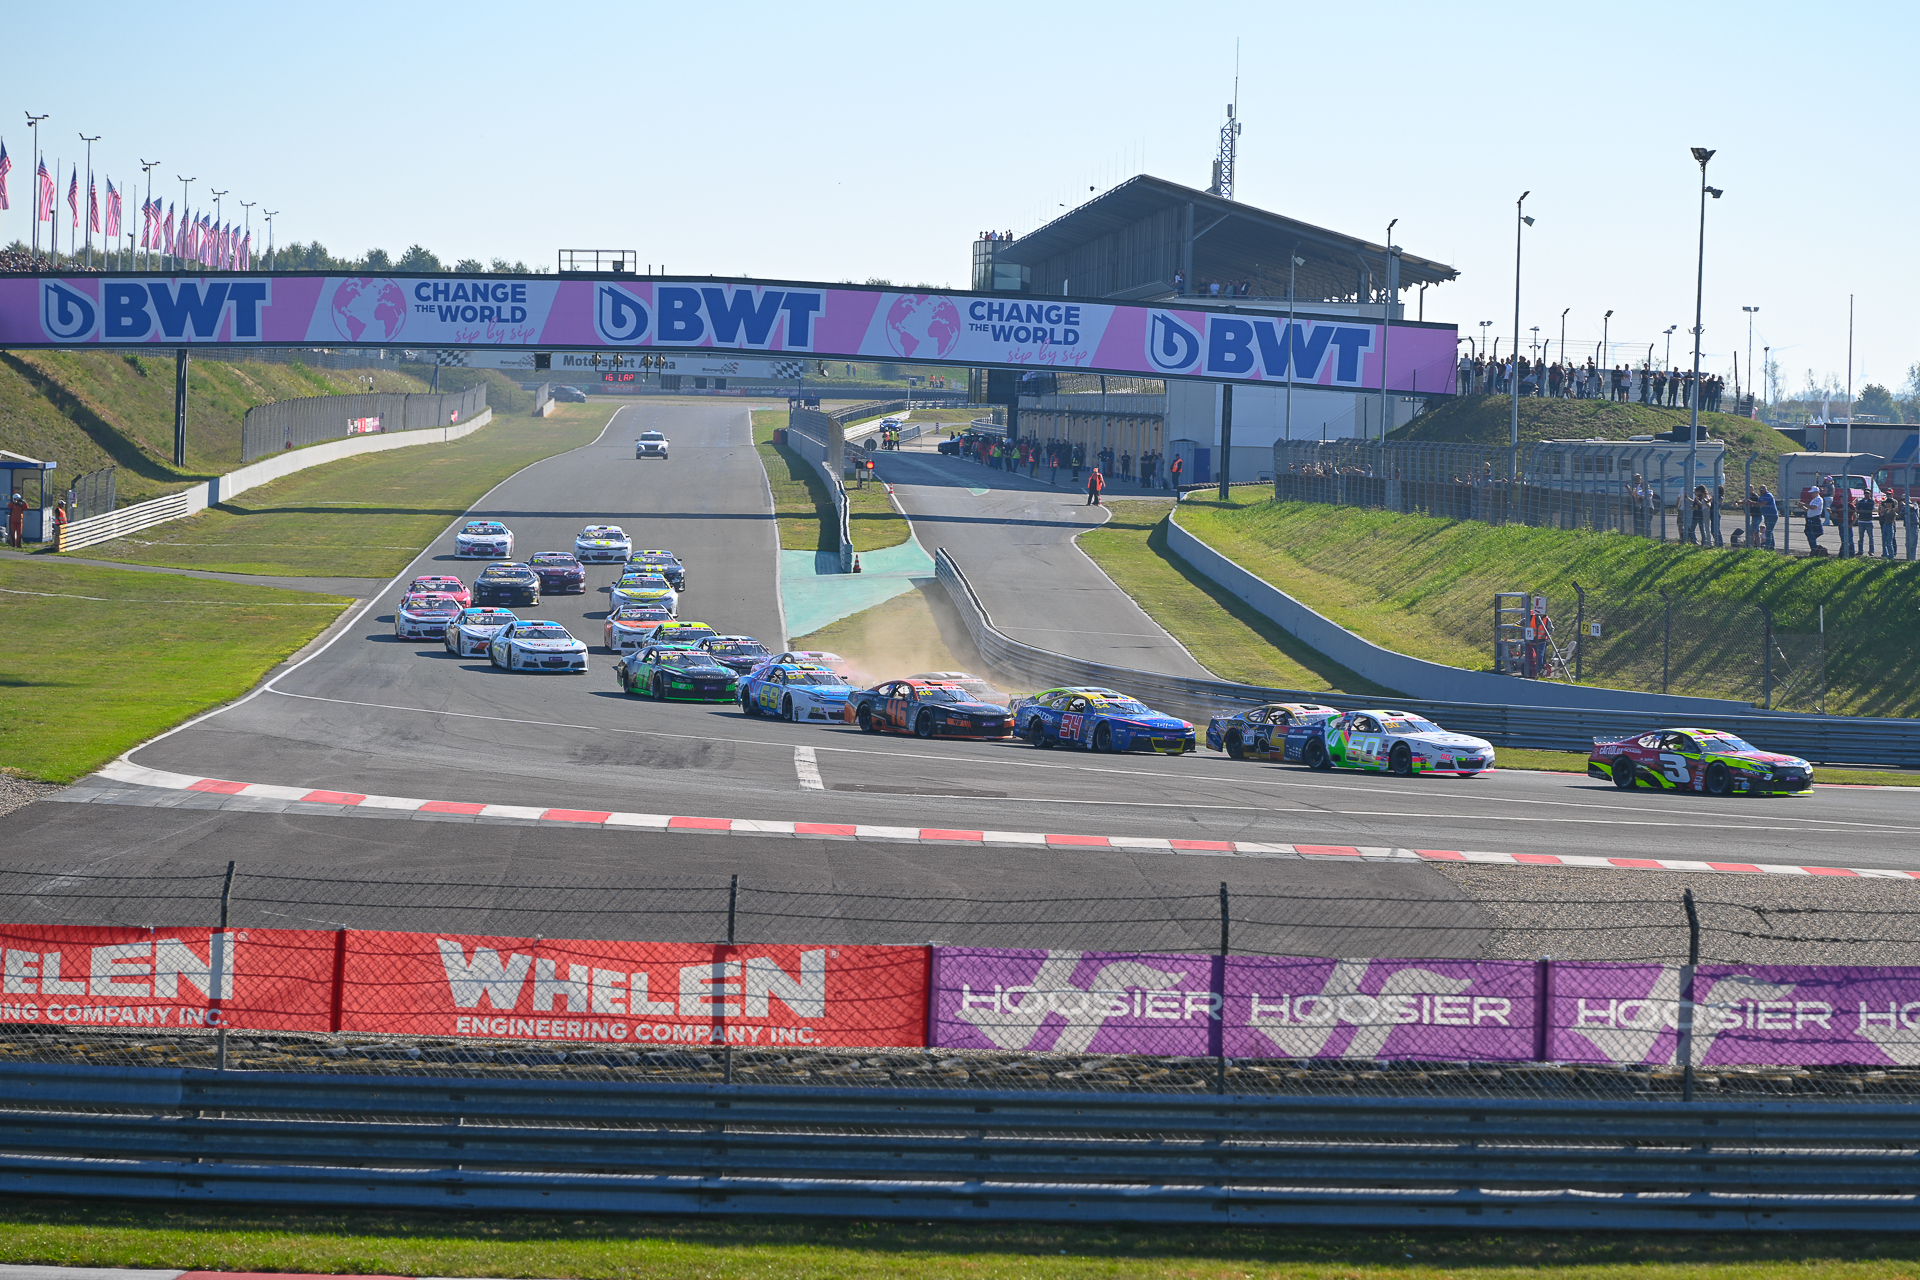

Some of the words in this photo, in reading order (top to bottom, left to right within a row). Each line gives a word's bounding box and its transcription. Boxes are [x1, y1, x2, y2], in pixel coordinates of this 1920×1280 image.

[414, 282, 527, 303] CHANGE
[104, 282, 267, 338] BWT
[414, 304, 436, 313] THE
[437, 304, 527, 324] WORLD
[657, 286, 821, 348] BWT
[968, 300, 1081, 326] CHANGE
[454, 326, 480, 344] sip
[486, 316, 505, 344] by
[509, 324, 536, 344] sip
[968, 322, 989, 332] THE
[990, 324, 1080, 346] WORLD
[1006, 346, 1033, 365] sip
[1038, 337, 1057, 366] by
[1061, 346, 1088, 367] sip
[1207, 317, 1371, 383] BWT
[604, 373, 614, 382] 16
[618, 373, 635, 382] LAP
[636, 664, 652, 689] 47
[759, 684, 779, 710] 69
[886, 698, 908, 727] 46
[1059, 713, 1084, 741] 34
[1345, 734, 1380, 764] 50
[1440, 753, 1451, 761] 50
[1658, 752, 1691, 784] 3
[0, 931, 234, 1000] ELEN
[436, 938, 826, 1018] WHELEN
[46, 1004, 172, 1024] COMPANY
[179, 1006, 228, 1026] INC.
[962, 983, 1223, 1021] HOOSIER
[1251, 993, 1511, 1026] HOOSIER
[1577, 997, 1832, 1030] HOOSIER
[456, 1016, 628, 1040] ENGINEERING
[634, 1023, 764, 1043] COMPANY
[770, 1026, 821, 1044] INC.
